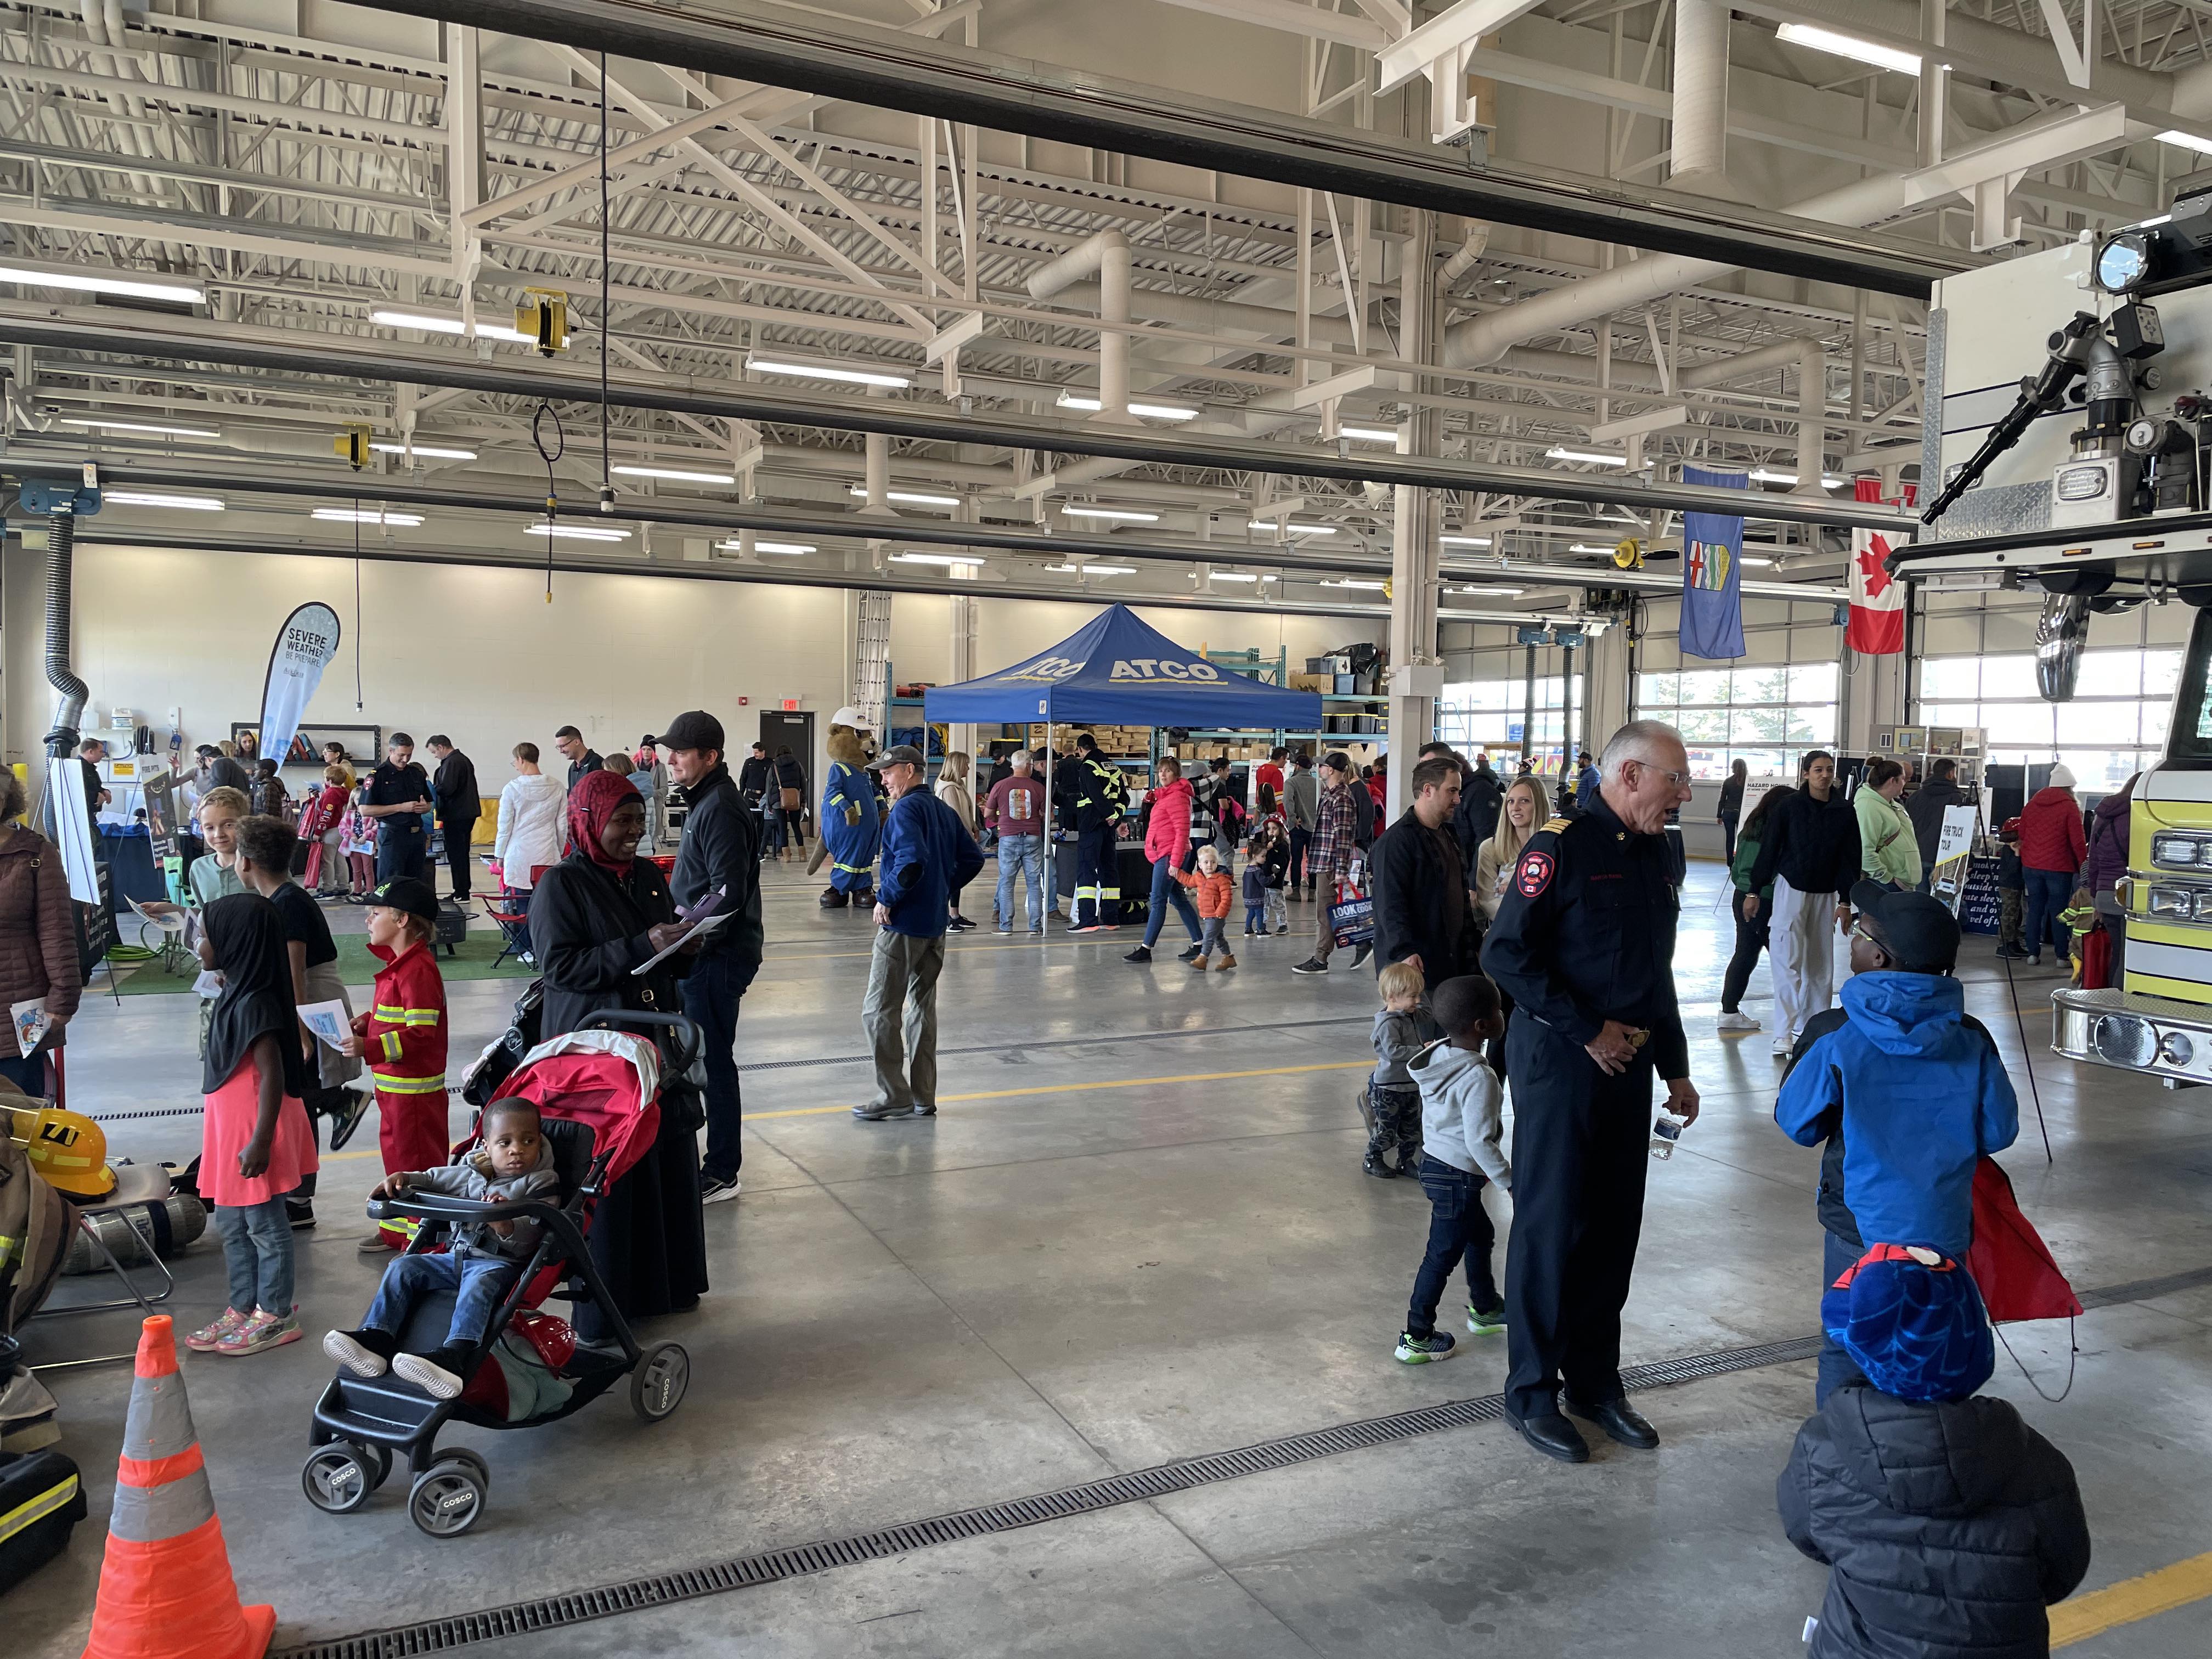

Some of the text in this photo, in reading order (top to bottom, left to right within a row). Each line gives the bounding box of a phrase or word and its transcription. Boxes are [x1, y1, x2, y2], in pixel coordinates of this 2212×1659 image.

[289, 628, 327, 650] SEVERE
[286, 651, 293, 660] BE
[287, 640, 323, 659] WEATHER
[1110, 659, 1218, 680] ATCO
[784, 700, 796, 710] EXIT
[1951, 826, 1964, 838] TRUCK
[1940, 839, 1951, 851] TOUR
[1333, 904, 1357, 918] LOOK
[1970, 904, 1988, 913] and
[1983, 916, 1994, 927] of
[662, 1378, 670, 1409] COSCO
[331, 1468, 356, 1485] COSCO
[443, 1493, 472, 1508] COSCO
